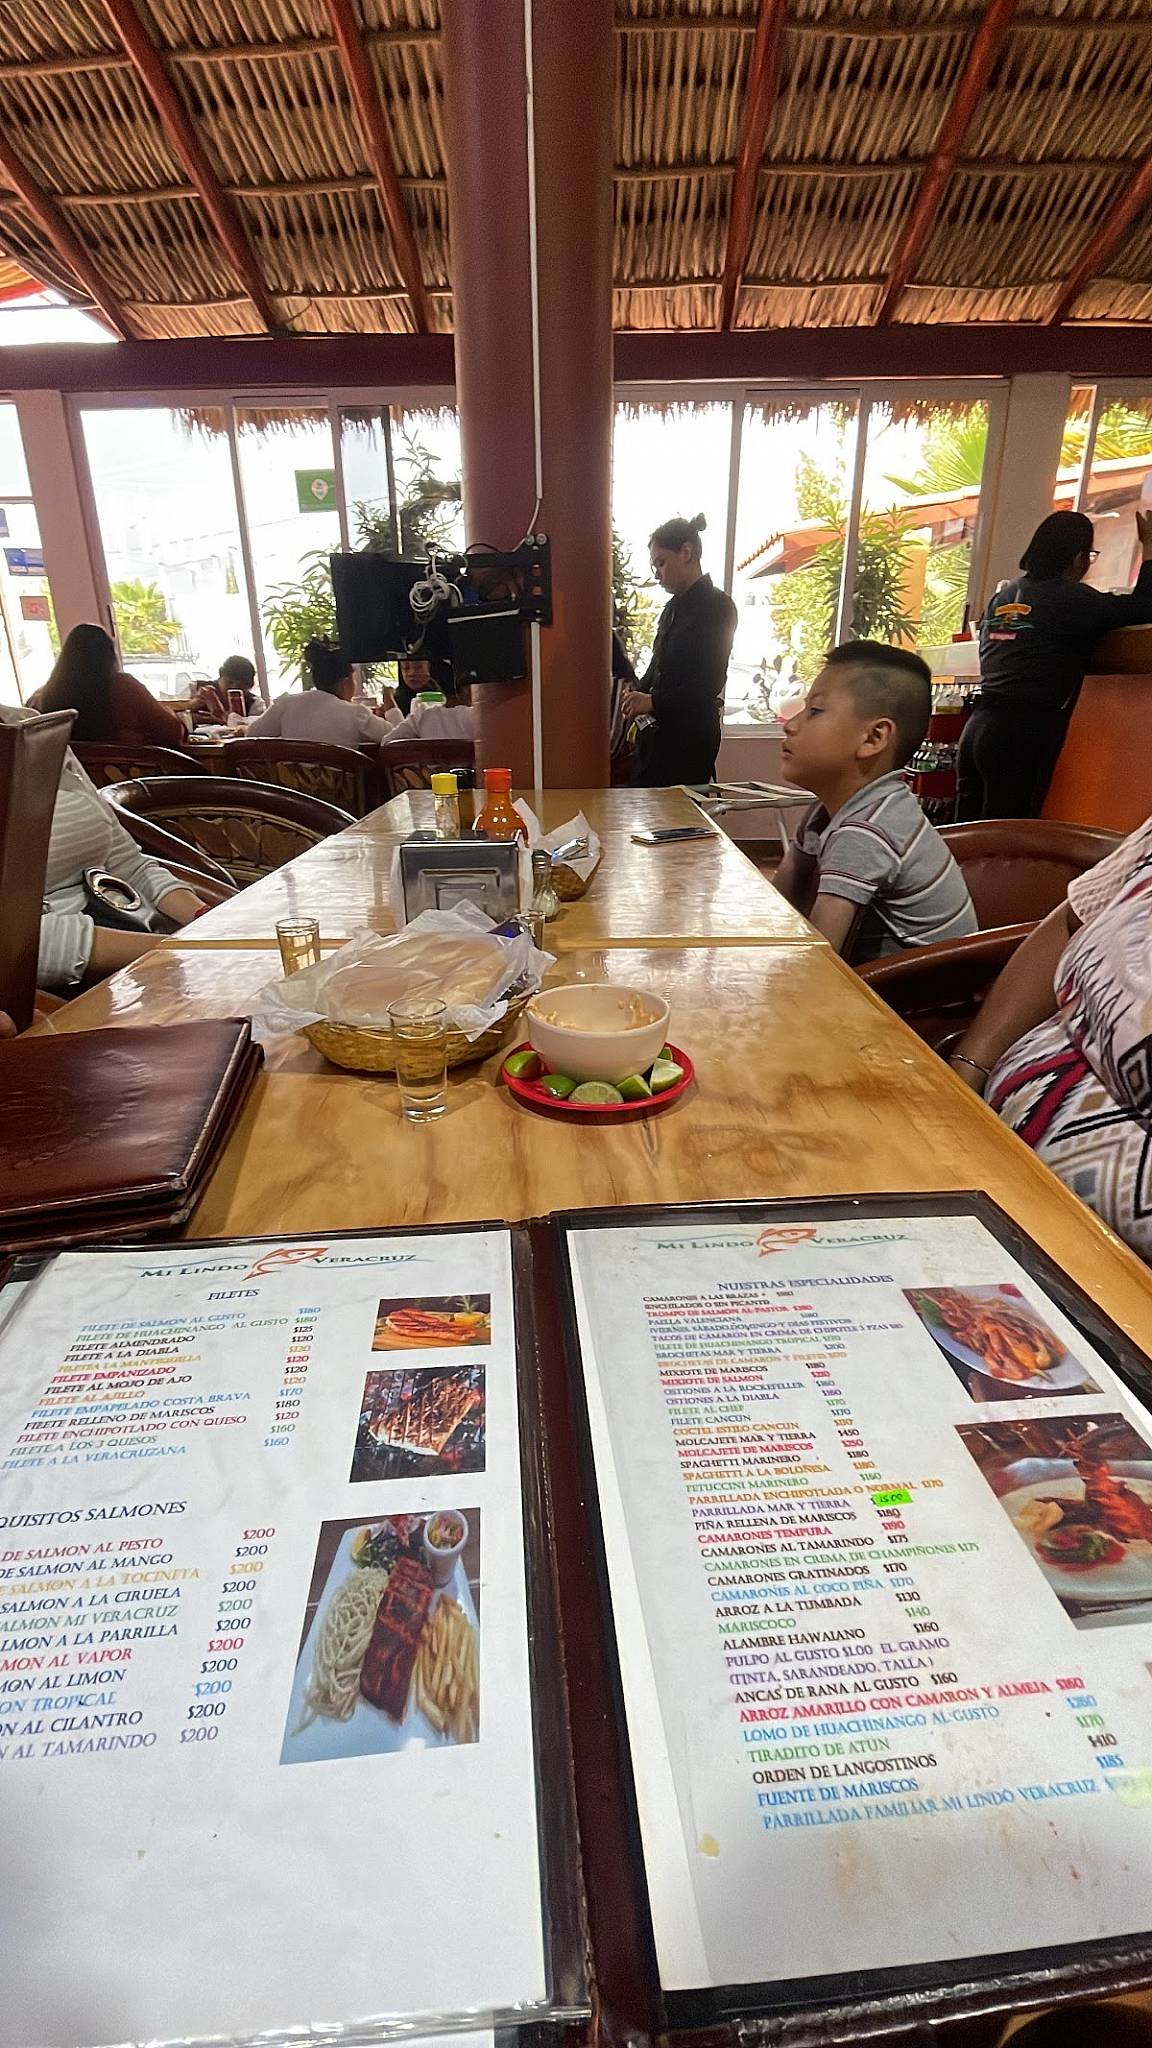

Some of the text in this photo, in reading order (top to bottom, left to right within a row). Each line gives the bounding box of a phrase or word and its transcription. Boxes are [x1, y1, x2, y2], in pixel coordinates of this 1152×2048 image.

[206, 1289, 259, 1300] FILETES
[63, 1352, 104, 1362] FILETE
[135, 1346, 179, 1357] DIABLA
[70, 1343, 109, 1352] FILETE
[109, 1335, 195, 1349] ALMENDRADO
[43, 1366, 308, 1395] FILETE AL MOJO DE AJO $120
[50, 1355, 309, 1384] FILETE EMPANIZADO $120
[24, 1399, 300, 1430] FILETE RELLENO DE MARISCOS $180
[31, 1388, 303, 1418] FILETE EMPAPELADO COSTA BRAVA $170
[0, 1437, 289, 1470] FILETE VERACRUZANA $160
[675, 1436, 738, 1447] MOLCAJETE
[740, 1434, 765, 1443] MAR
[777, 1432, 817, 1441] TIERRA
[680, 1455, 801, 1469] SPAGHETTI MARINERO
[686, 1481, 746, 1493] FETUCCINI
[748, 1478, 809, 1489] MARINERO
[688, 1493, 761, 1505] PARRILLADA
[764, 1487, 851, 1500] ENCHIPOTLADA
[853, 1486, 864, 1494] O
[84, 1501, 187, 1521] SALMONES
[694, 1512, 857, 1531] PIÑA RELLENA DE MARISCOS
[1, 1527, 275, 1562] DE SALMON AL PESTO $200
[698, 1526, 832, 1544] CAMARONES TEMPURA
[701, 1544, 777, 1557] CAMARONES
[780, 1543, 797, 1552] AL
[799, 1537, 874, 1551] TAMARINDO
[16, 1545, 268, 1578] SALMON AL MANGO $200
[708, 1572, 785, 1587] CAMARONES
[788, 1565, 871, 1580] GRATINADOS
[0, 1580, 256, 1614] SALMON A LA CIRUELA $200
[715, 1605, 760, 1618] ARROZ
[763, 1603, 773, 1614] A
[775, 1602, 794, 1612] LA
[797, 1597, 863, 1610] TUMBADA
[0, 1599, 253, 1632] ALMON MI VERACRUZ $200
[718, 1618, 797, 1633] MARISCOCO
[0, 1617, 251, 1650] LMON A LA PARRILLA $200
[723, 1635, 785, 1650] ALAMBRE
[788, 1628, 866, 1645] HAWAIANO
[0, 1637, 244, 1672] MON AL VAPOR $200
[725, 1638, 950, 1667] PULPO AL GUSTO EL GRAMO
[881, 1657, 927, 1671] TALLA
[38, 1676, 62, 1690] AL
[66, 1669, 127, 1687] LIMON
[200, 1658, 238, 1674] $200
[32, 1691, 117, 1711] TROPICAL
[194, 1680, 232, 1697] $200
[735, 1689, 782, 1703] ANCAS
[786, 1687, 804, 1699] DE
[808, 1683, 849, 1697] RANA
[853, 1681, 872, 1693] AL
[874, 1676, 920, 1691] GUSTO
[740, 1708, 789, 1723] ARROZ
[793, 1700, 867, 1720] AMARILLO
[870, 1696, 903, 1710] CON
[998, 1681, 1052, 1698] ALMEJA
[20, 1719, 44, 1735] AL
[50, 1710, 144, 1732] CILANTRO
[187, 1702, 226, 1719] $200
[743, 1706, 1000, 1742] LOMO DE HUACHINANGO AL GUSTO
[12, 1743, 36, 1760] AL
[42, 1732, 157, 1757] TAMARINDO
[179, 1726, 219, 1743] $200
[747, 1745, 820, 1763] TIRADITO
[823, 1743, 846, 1755] DE
[752, 1768, 806, 1785] ORDEN
[811, 1766, 831, 1779] DE
[835, 1754, 938, 1777] LANGOSTINOS
[757, 1789, 815, 1806] FUENTE
[820, 1787, 840, 1800] DE
[843, 1778, 920, 1798] MARISCOS
